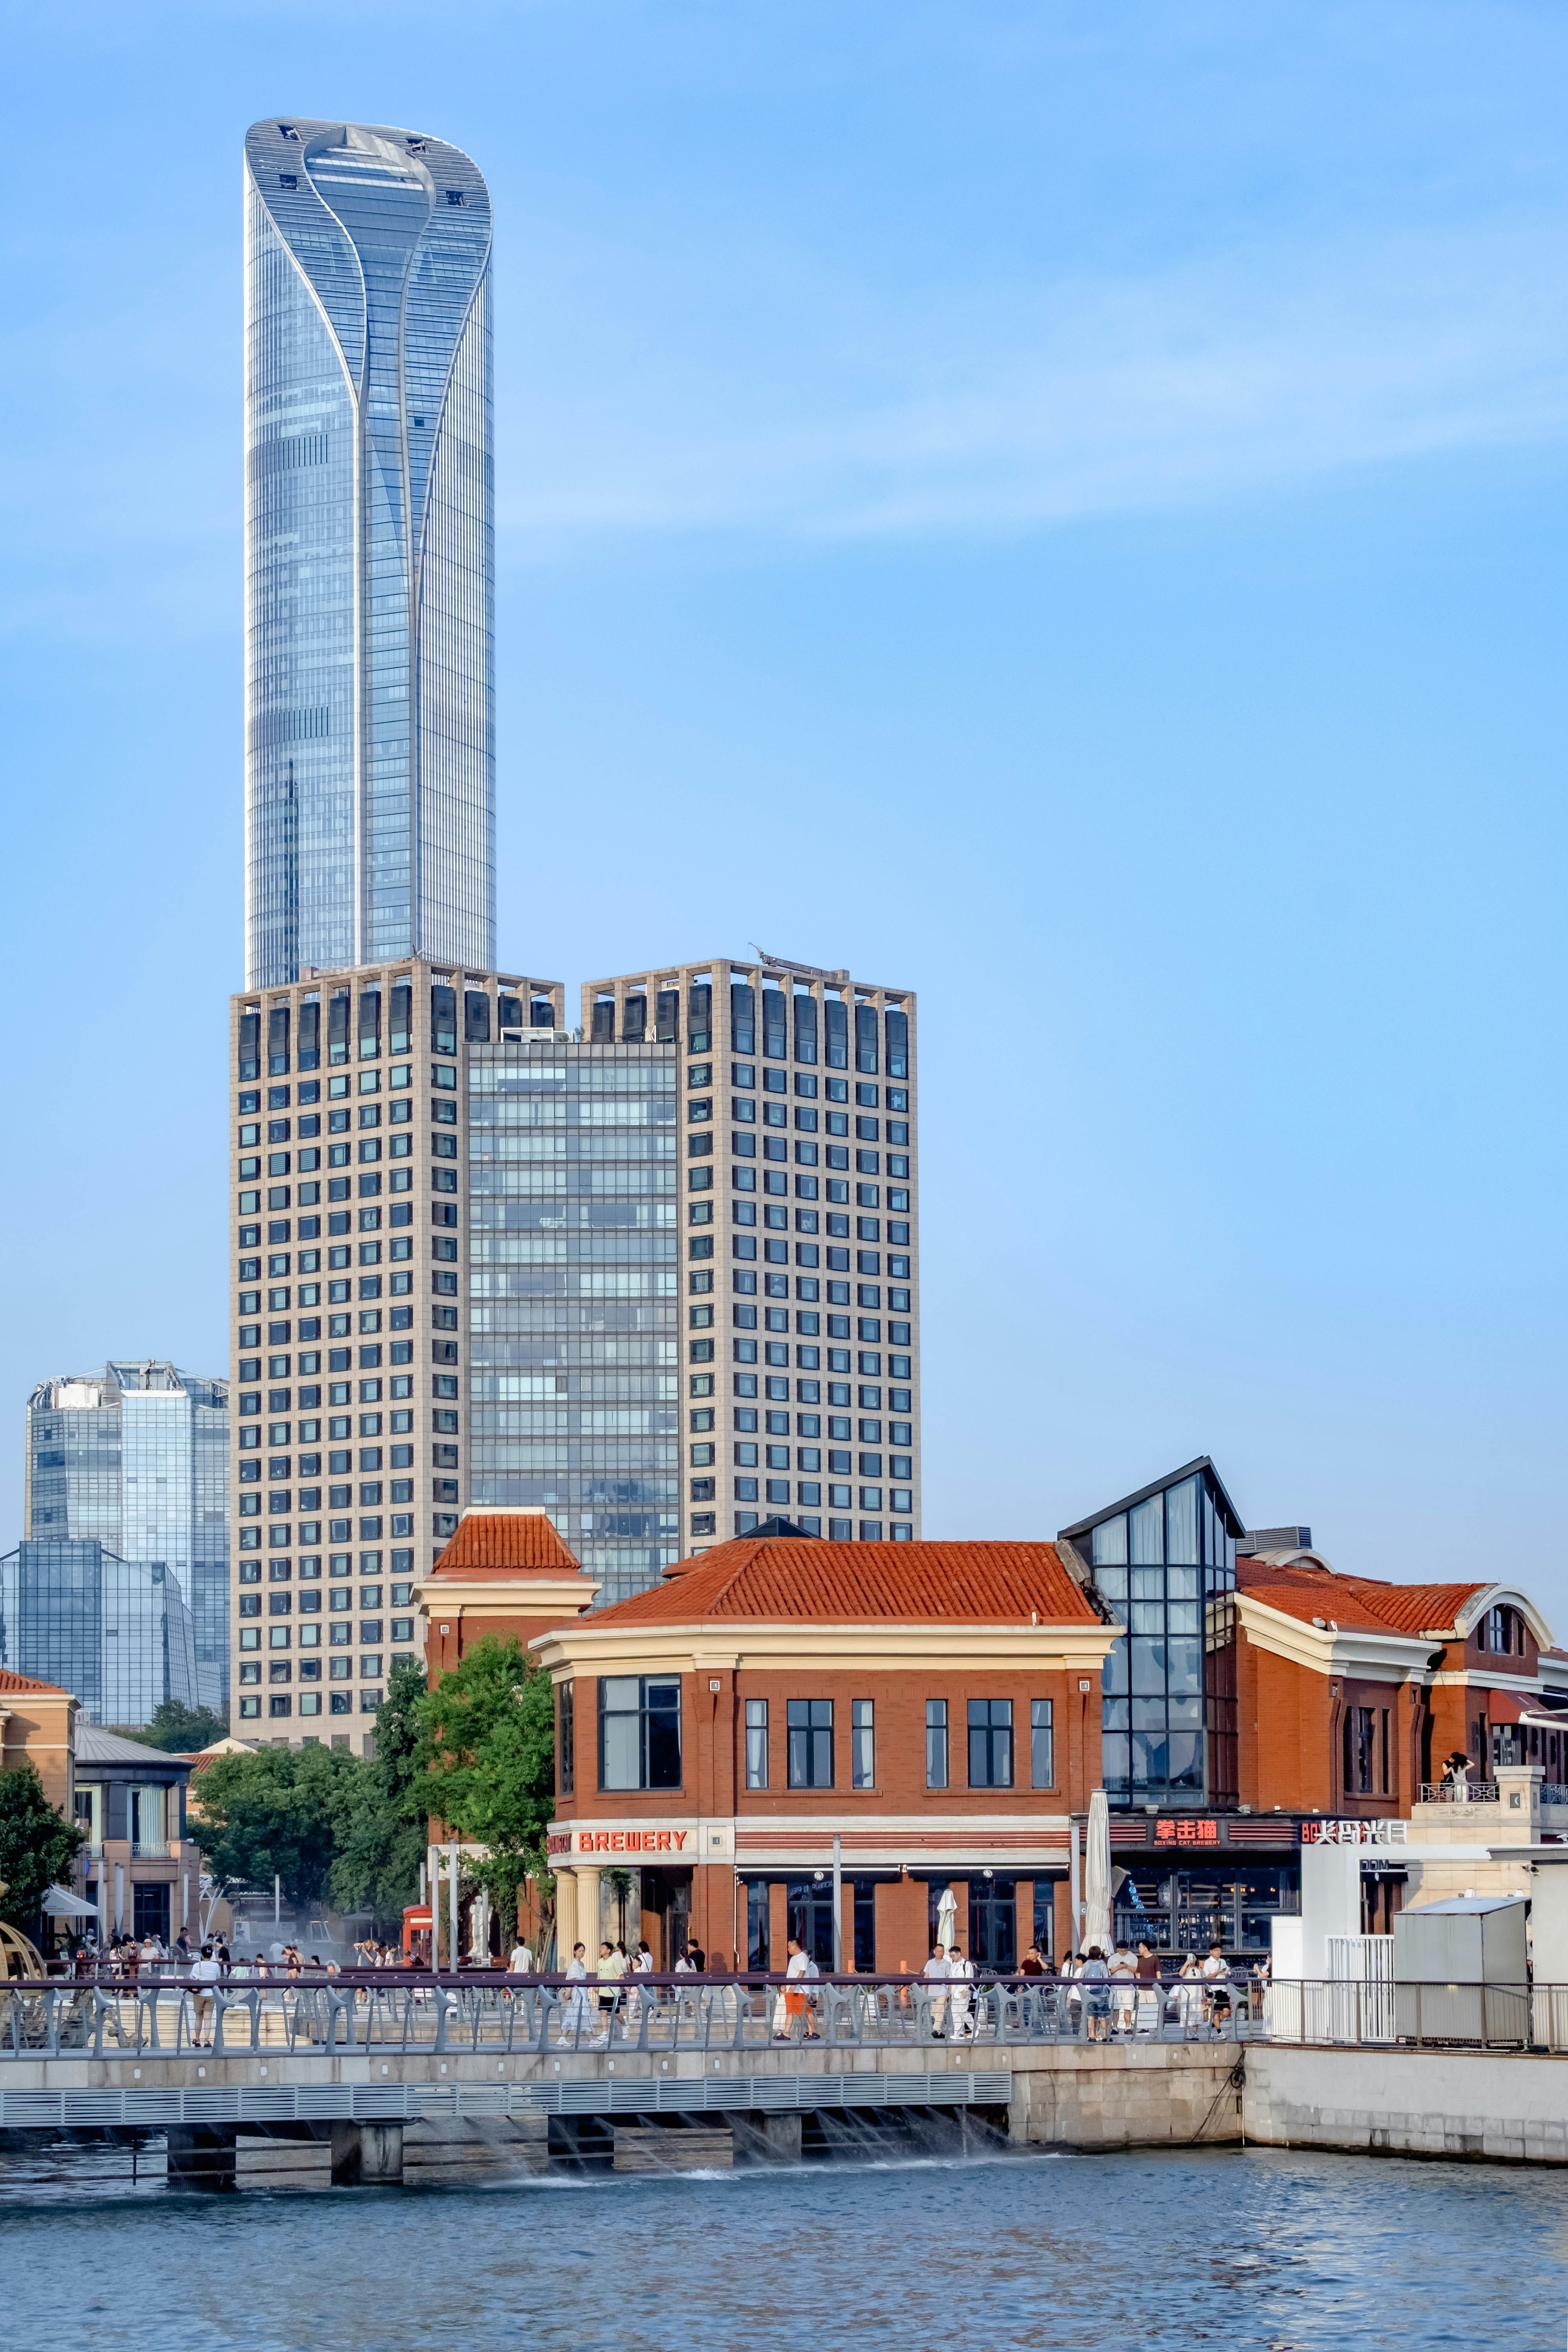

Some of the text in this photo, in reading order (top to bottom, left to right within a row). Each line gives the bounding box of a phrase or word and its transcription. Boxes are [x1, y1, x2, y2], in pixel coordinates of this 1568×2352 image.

[1156, 1820, 1216, 1839] 拳击猫
[579, 1831, 687, 1851] BREWERY
